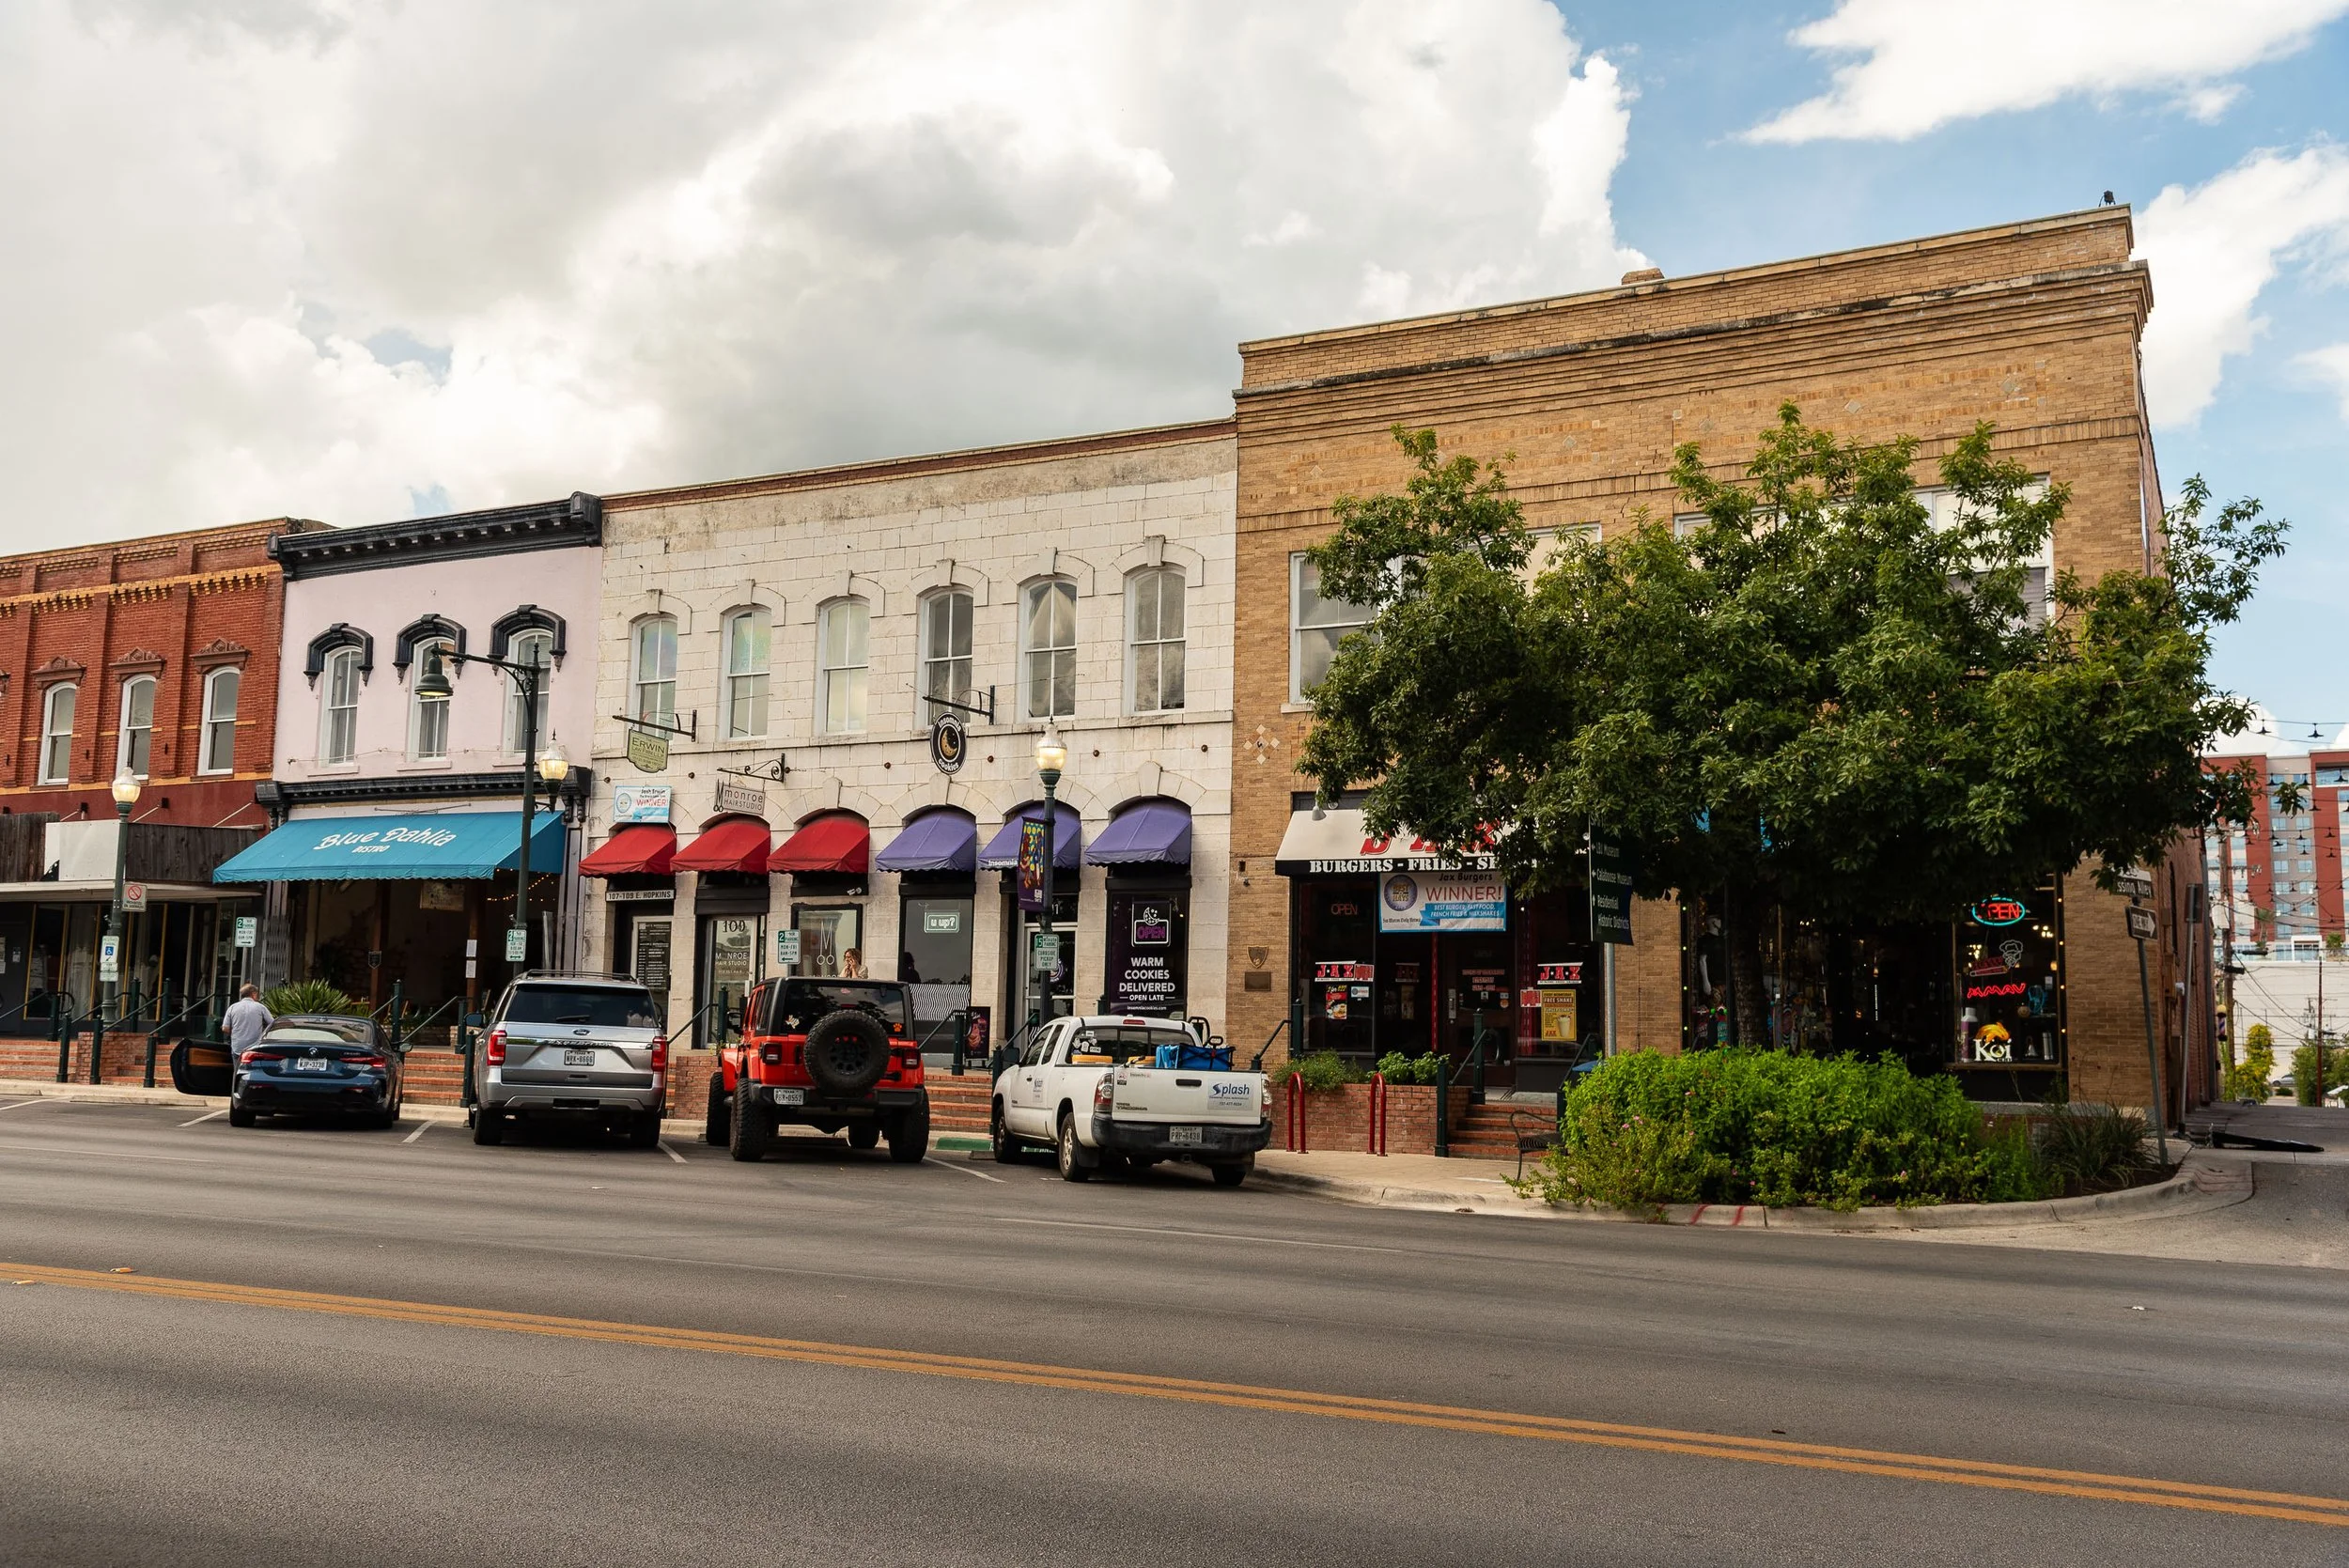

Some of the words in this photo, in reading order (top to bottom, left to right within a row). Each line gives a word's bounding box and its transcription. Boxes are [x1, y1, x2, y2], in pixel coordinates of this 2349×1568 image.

[631, 737, 665, 753] ERWIN
[724, 789, 763, 803] monroe
[313, 832, 380, 850] Blue
[381, 828, 457, 846] Dahlia
[1310, 860, 1393, 873] BURGERS
[1439, 873, 1455, 881] Jax
[1457, 873, 1492, 881] Burgers
[1425, 886, 1501, 901] WINNER!
[1330, 903, 1358, 915] OPEN
[1979, 903, 2020, 919] PEN
[238, 919, 243, 928] 2
[930, 919, 937, 927] u
[938, 917, 956, 929] up?
[779, 931, 786, 942] 2
[1136, 926, 1166, 939] OPEN
[1130, 957, 1164, 967] WARM
[1125, 970, 1170, 979] COOKIES
[1119, 983, 1175, 992] DELIVERED
[1974, 1038, 2013, 1062] Koi
[1209, 1082, 1250, 1097] Splash
